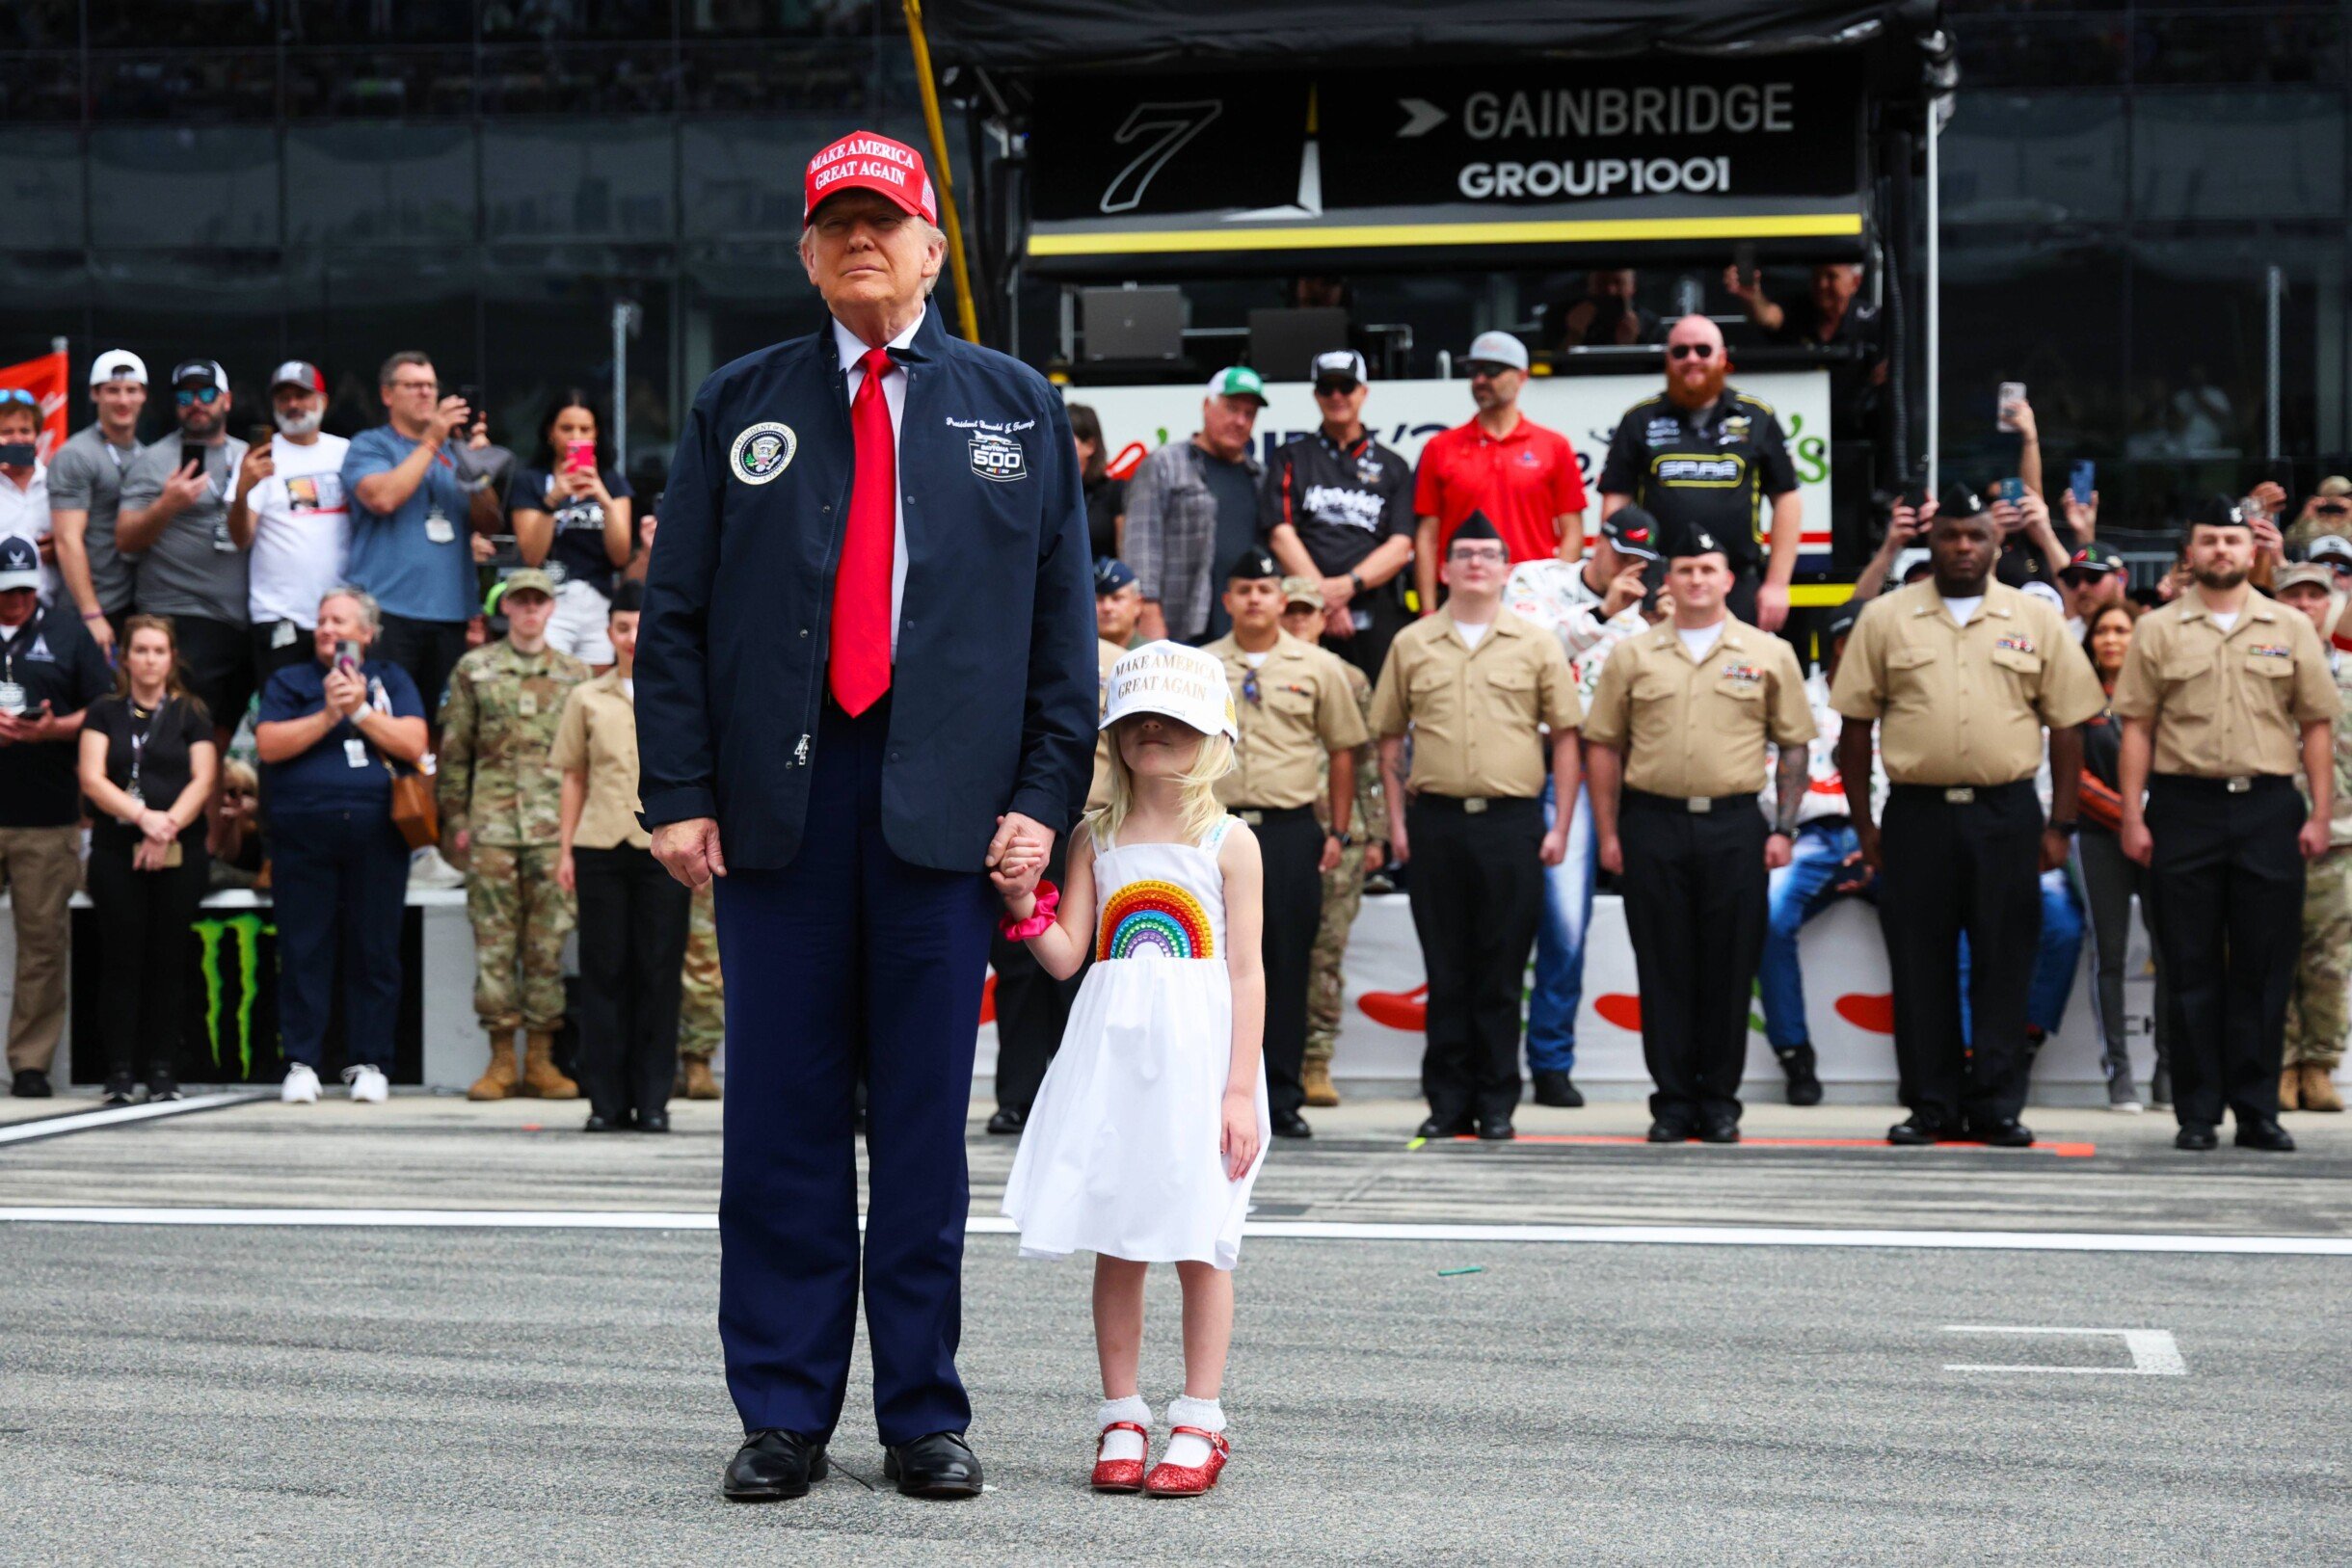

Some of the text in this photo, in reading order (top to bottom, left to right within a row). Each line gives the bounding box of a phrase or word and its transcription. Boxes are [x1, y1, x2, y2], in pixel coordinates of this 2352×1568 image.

[1462, 82, 1795, 141] GAINBRIDGE
[810, 139, 916, 174] MAKE AMERICA
[1100, 99, 1222, 214] 7
[815, 160, 907, 191] GREAT AGAIN
[1457, 155, 1732, 199] GROUP1001
[735, 424, 772, 450] PRESIDENT
[946, 416, 978, 428] President
[1012, 418, 1035, 431] Trump
[973, 450, 1021, 468] 500
[980, 444, 1009, 453] DAYTONA
[1114, 653, 1217, 683] MAKE AMERICA
[1118, 675, 1208, 702] GREAT AGAIN
